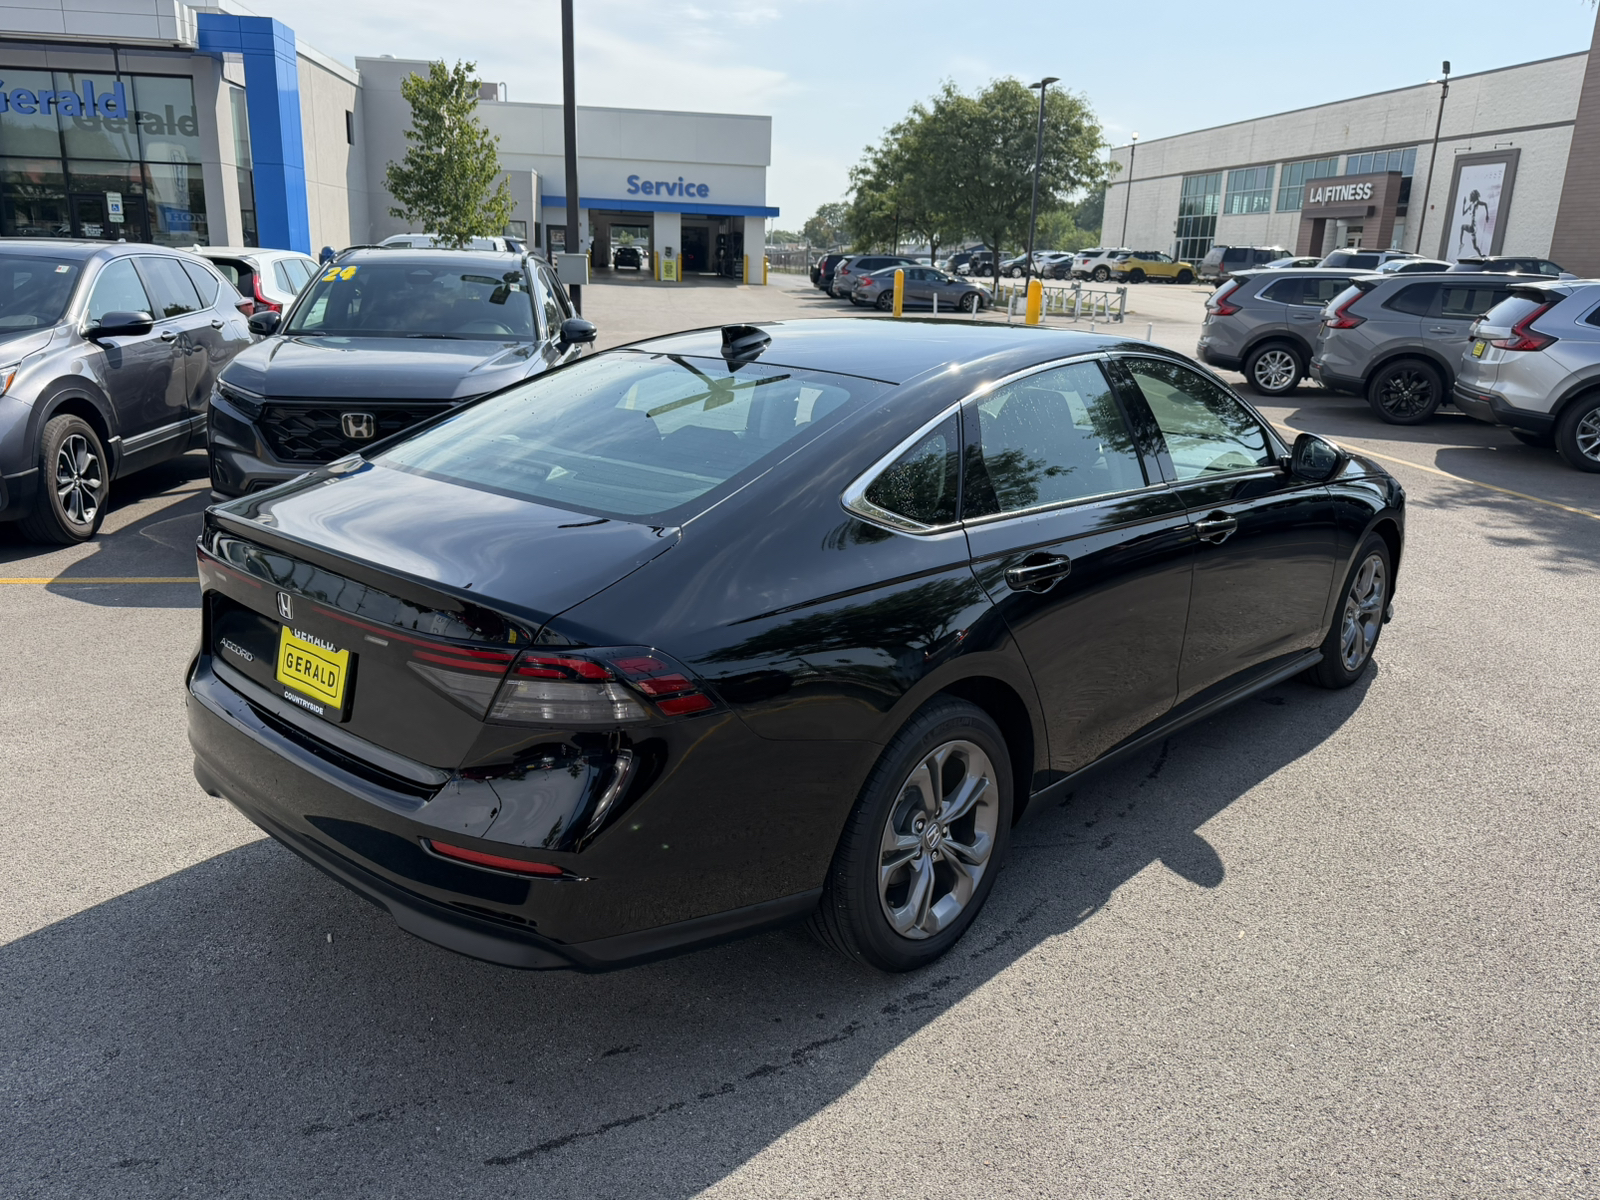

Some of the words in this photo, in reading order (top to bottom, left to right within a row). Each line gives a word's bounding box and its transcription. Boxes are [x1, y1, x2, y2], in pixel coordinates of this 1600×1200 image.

[626, 174, 710, 198] Service
[1324, 182, 1373, 202] FITNESS
[321, 265, 357, 282] 24
[219, 637, 254, 662] ACCORD
[286, 652, 336, 688] GERALD
[283, 691, 324, 716] COUNTRYSIDE
